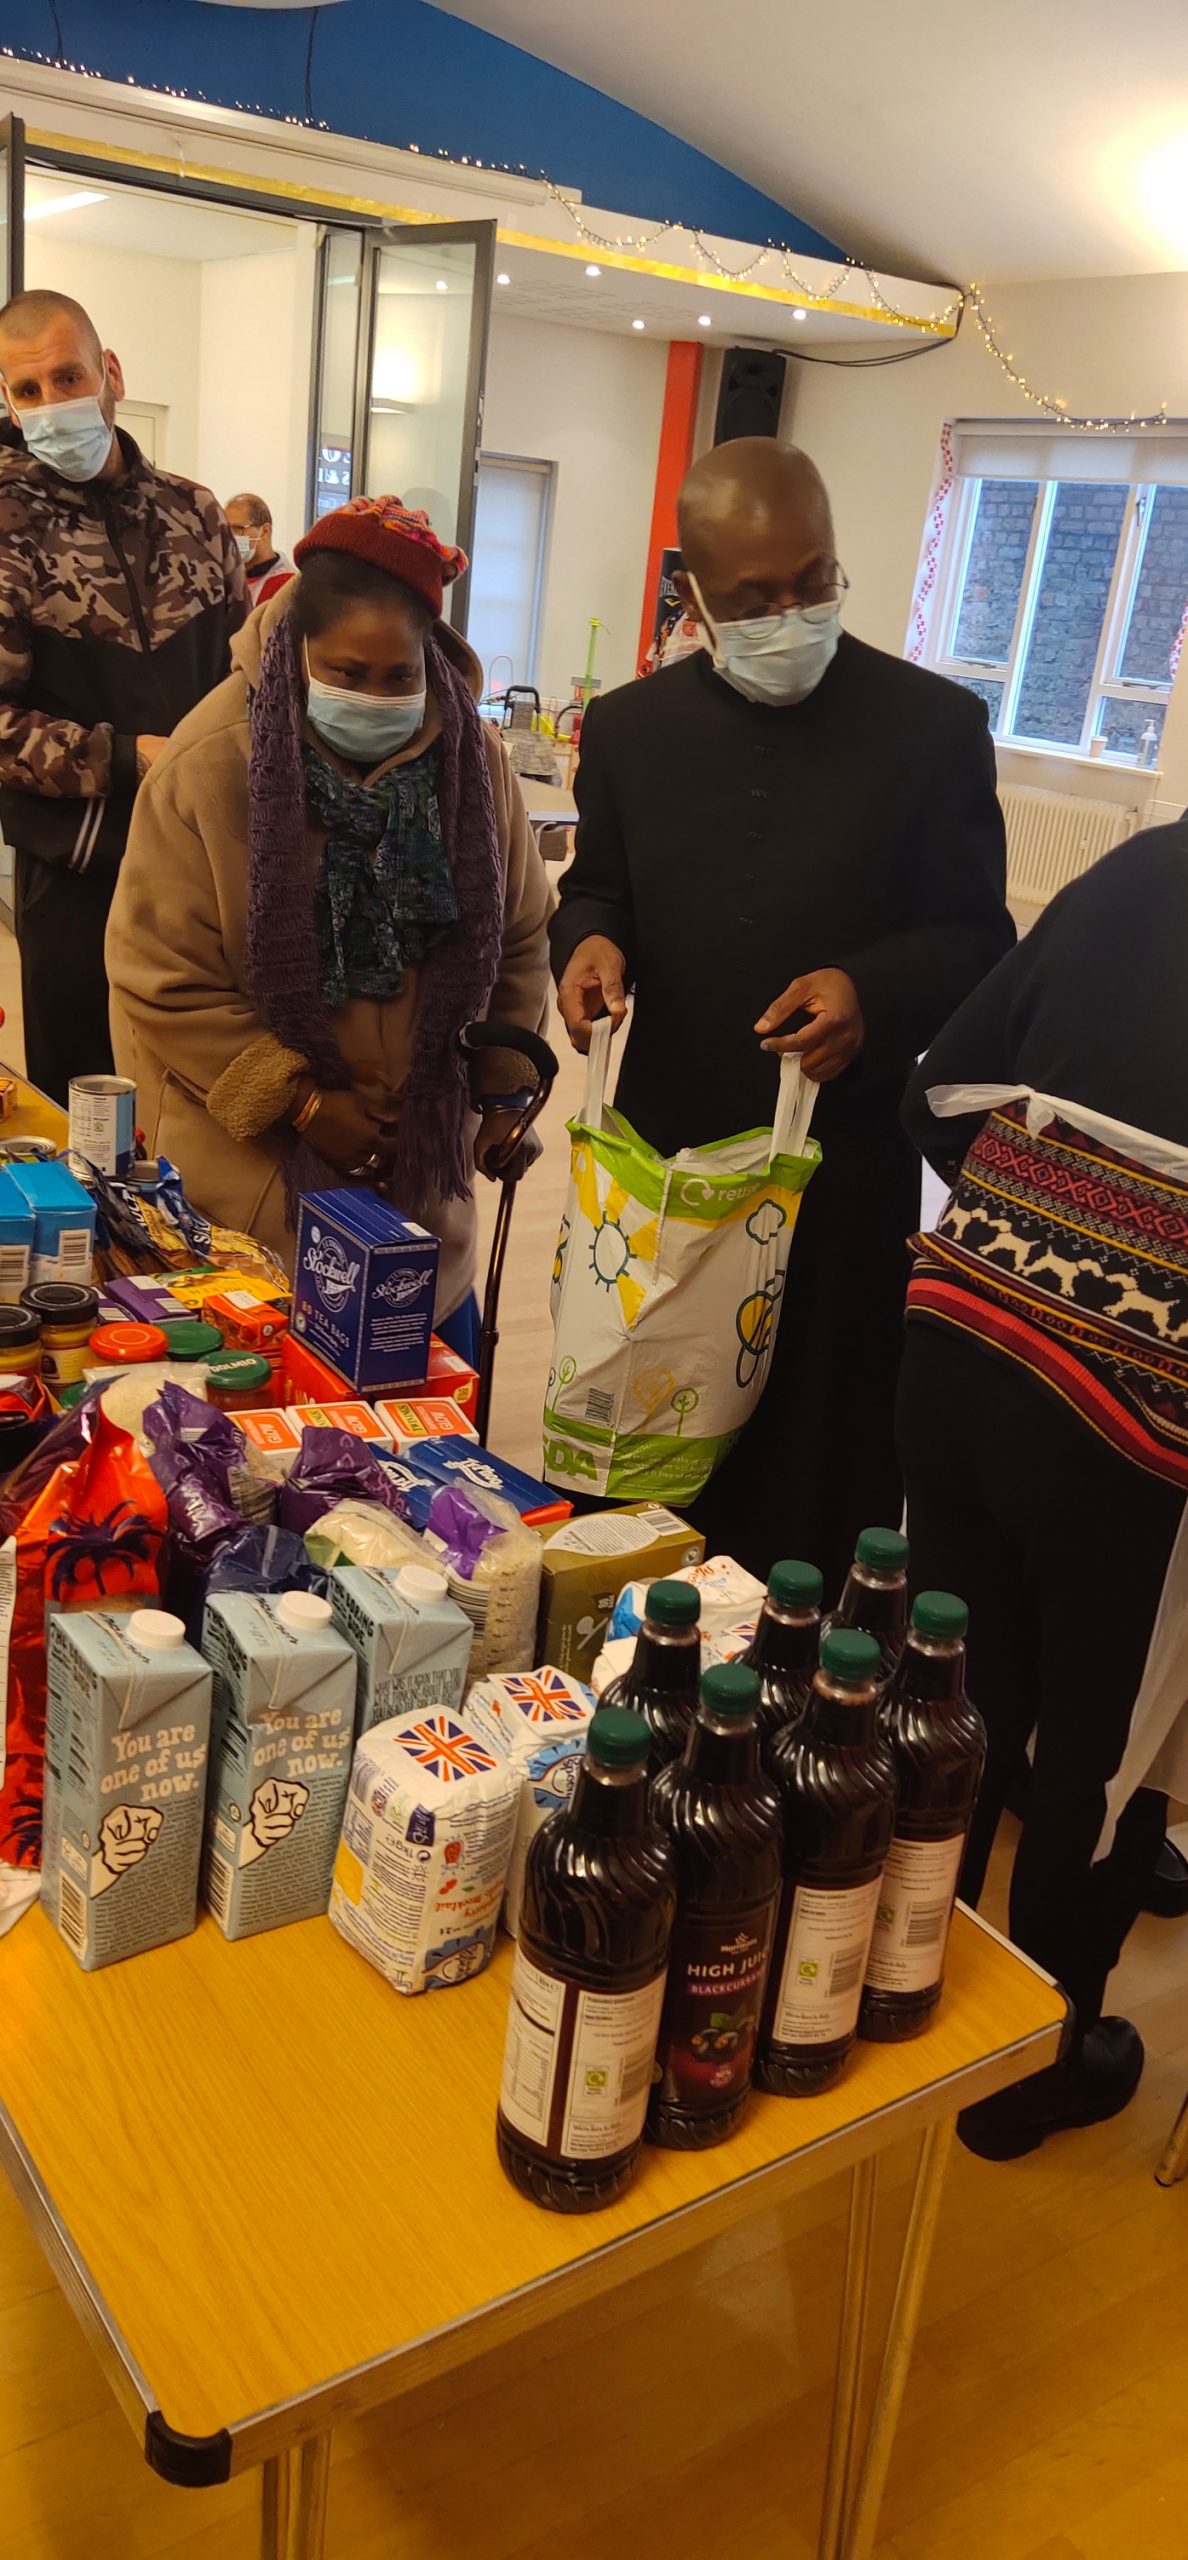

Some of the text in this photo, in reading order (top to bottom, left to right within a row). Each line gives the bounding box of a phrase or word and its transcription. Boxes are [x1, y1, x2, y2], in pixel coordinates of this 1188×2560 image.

[303, 1247, 360, 1285] Stockwell
[371, 1269, 433, 1299] Stockwell
[314, 1307, 330, 1333] TEA
[331, 1323, 351, 1348] BAGS
[209, 1358, 257, 1373] DOLMIO
[259, 1708, 342, 1734] You are
[112, 1724, 195, 1762] You are
[254, 1726, 351, 1766] one of us
[100, 1743, 206, 1794] one of us
[287, 1752, 343, 1778] now.
[140, 1772, 199, 1802] now.
[687, 1961, 735, 1978] HIGH
